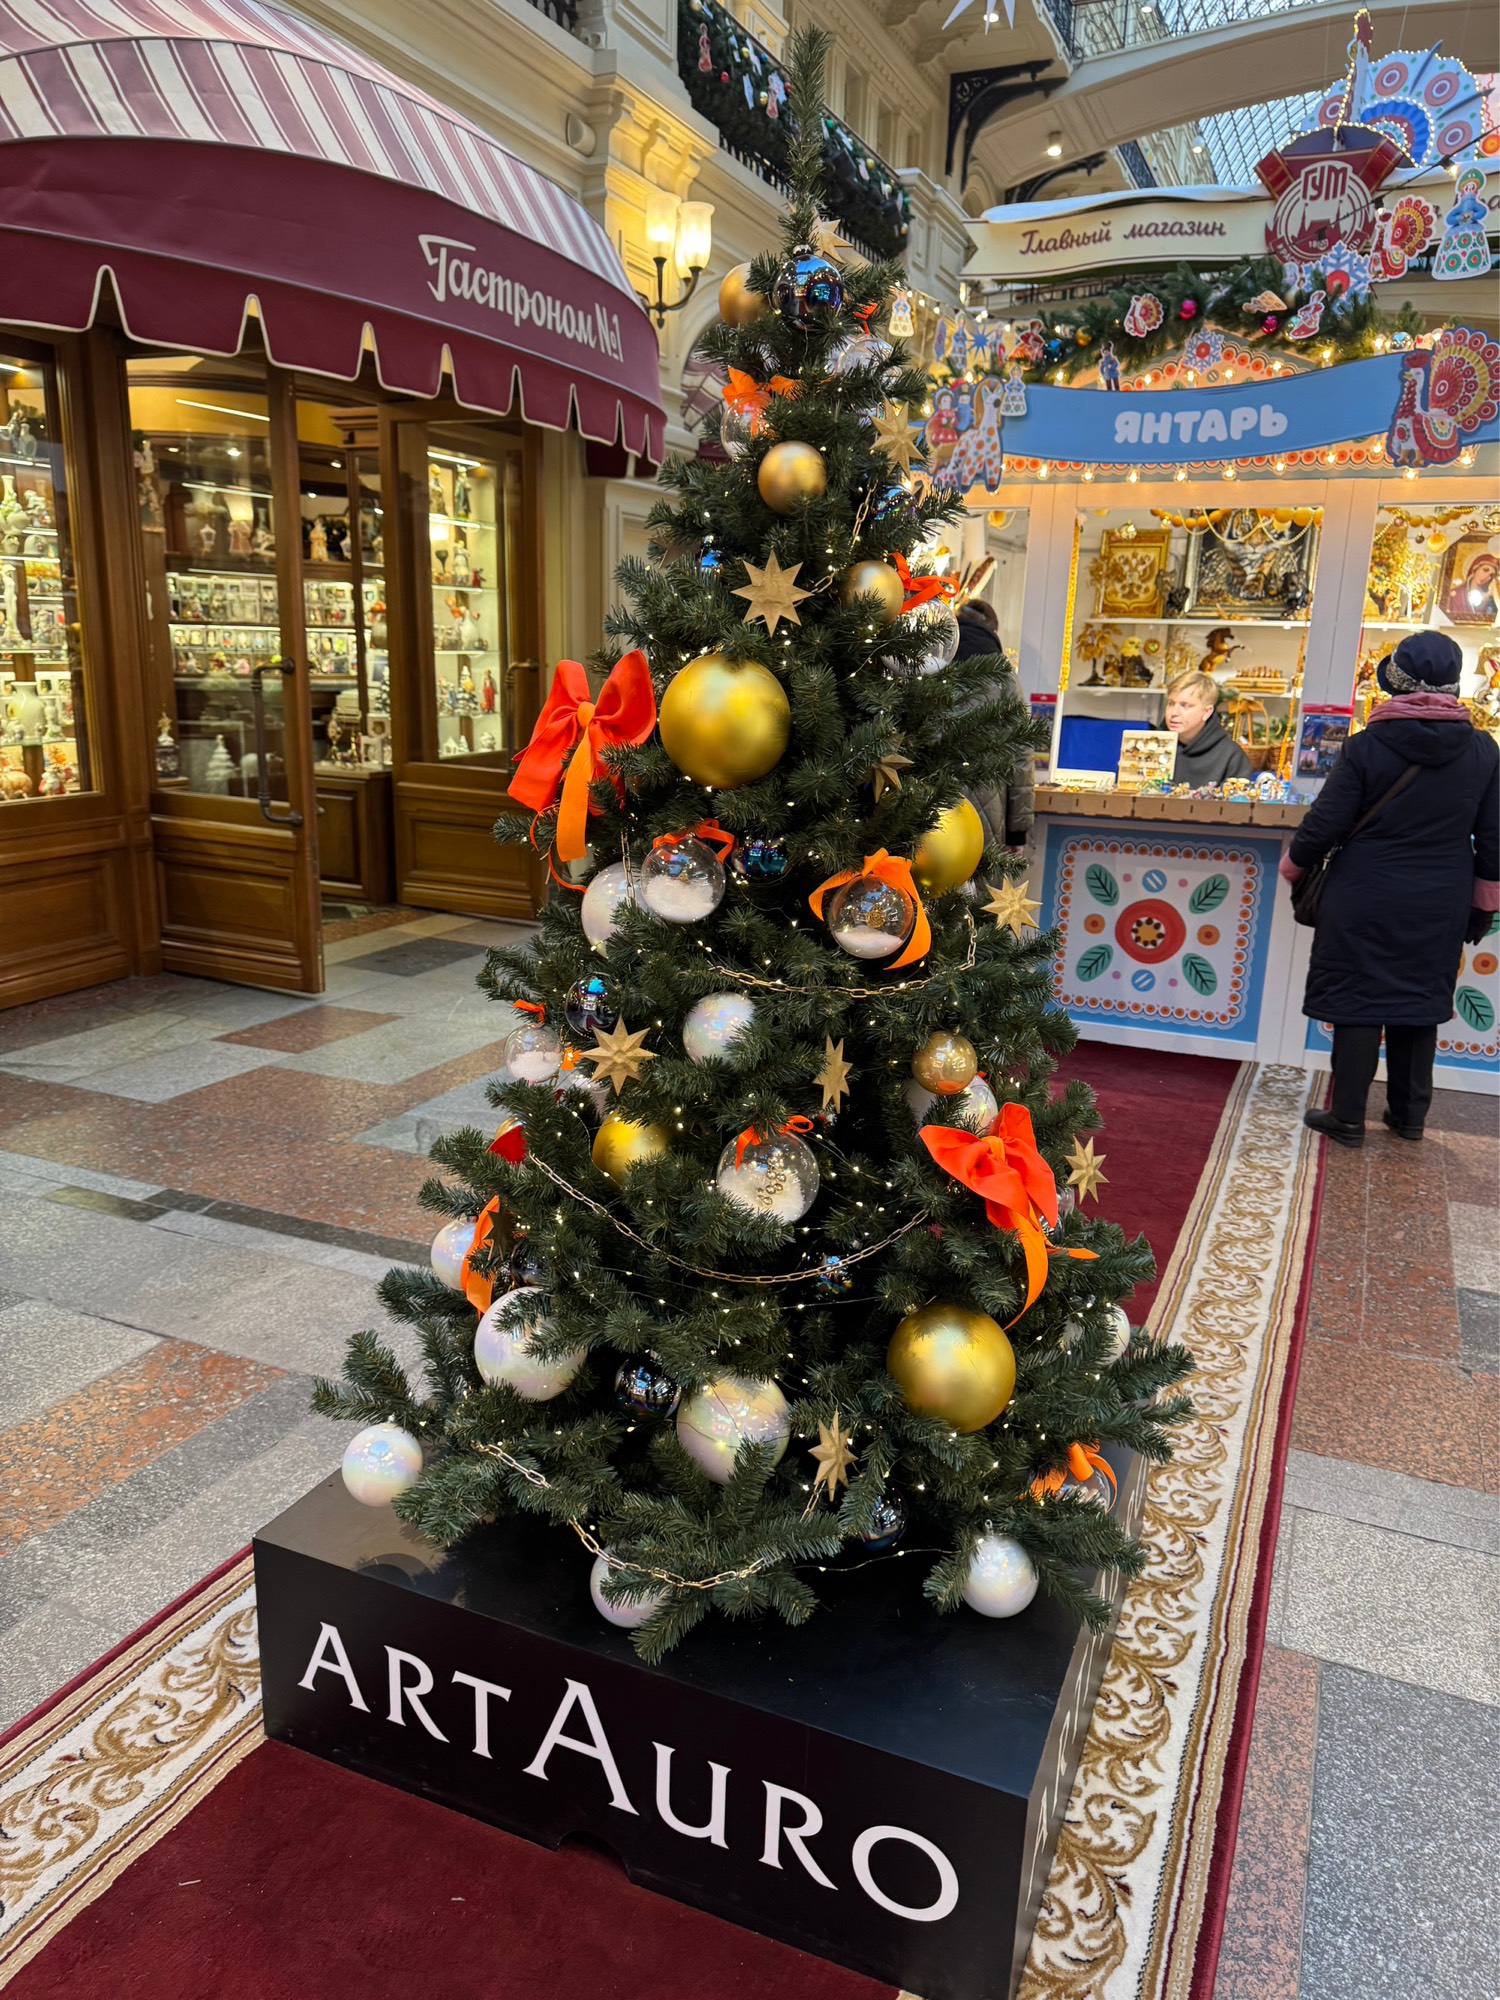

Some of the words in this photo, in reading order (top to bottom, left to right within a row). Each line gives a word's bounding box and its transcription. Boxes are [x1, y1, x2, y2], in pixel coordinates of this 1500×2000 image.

[1302, 164, 1348, 201] ГУМ
[1019, 220, 1112, 254] Главный
[1123, 220, 1226, 240] магазин
[418, 234, 597, 349] Гастроном
[594, 302, 624, 363] №1
[1114, 404, 1288, 444] ЯНТАРЬ
